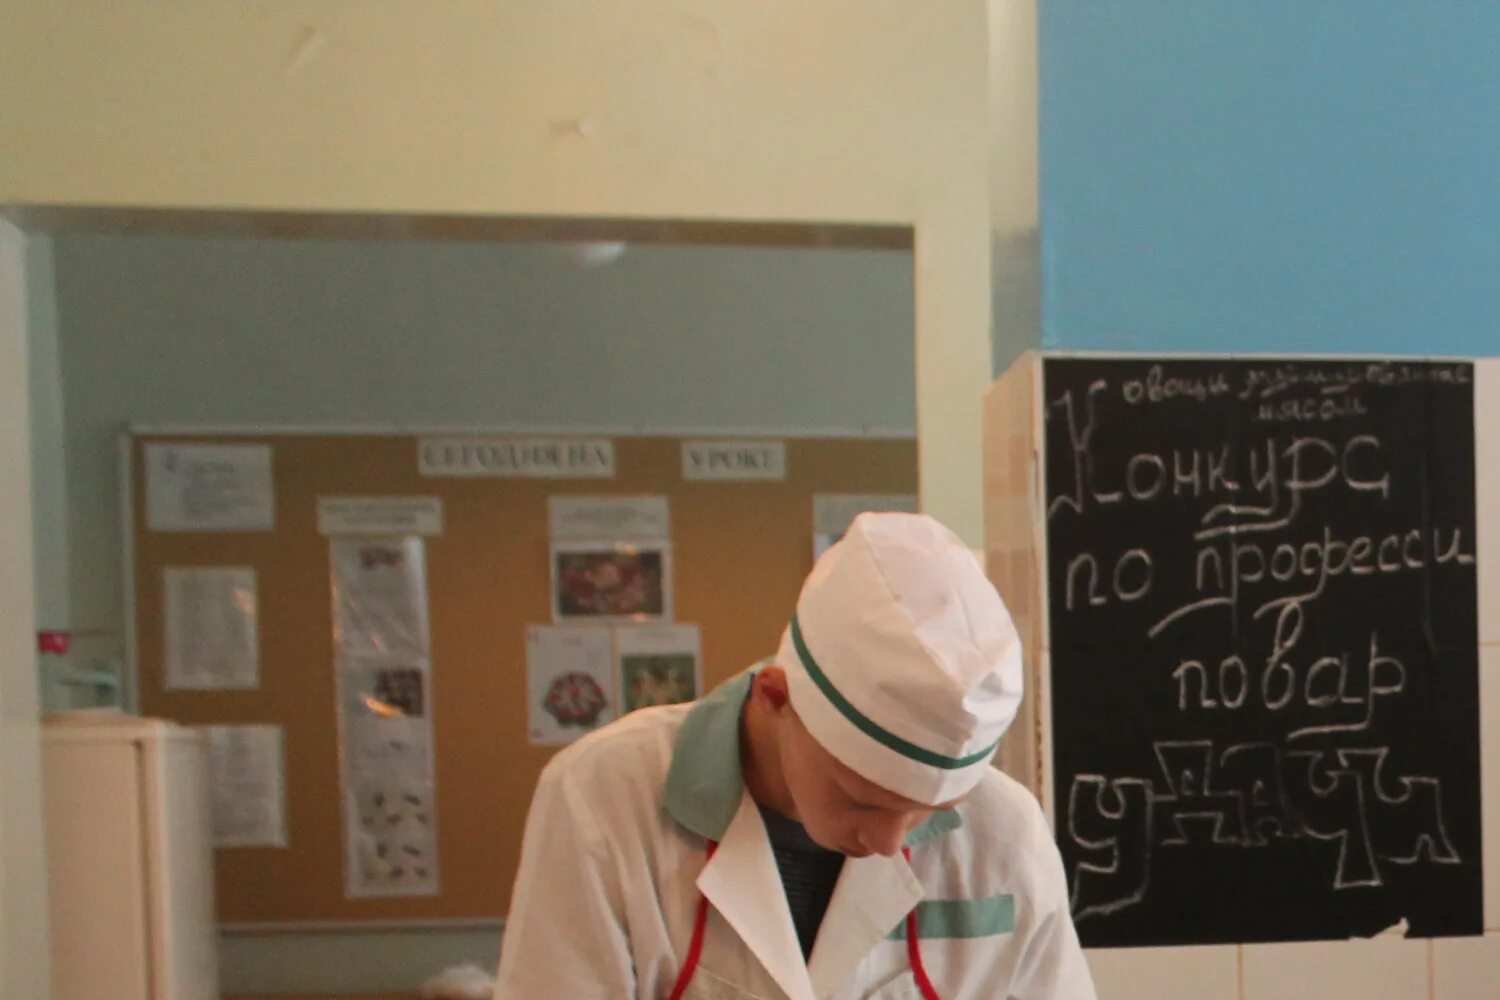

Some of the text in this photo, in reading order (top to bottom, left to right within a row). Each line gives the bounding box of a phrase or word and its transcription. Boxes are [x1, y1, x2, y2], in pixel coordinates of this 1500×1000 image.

[1046, 379, 1391, 540] Конкурс
[1064, 548, 1154, 611] по
[1172, 602, 1406, 740] повар
